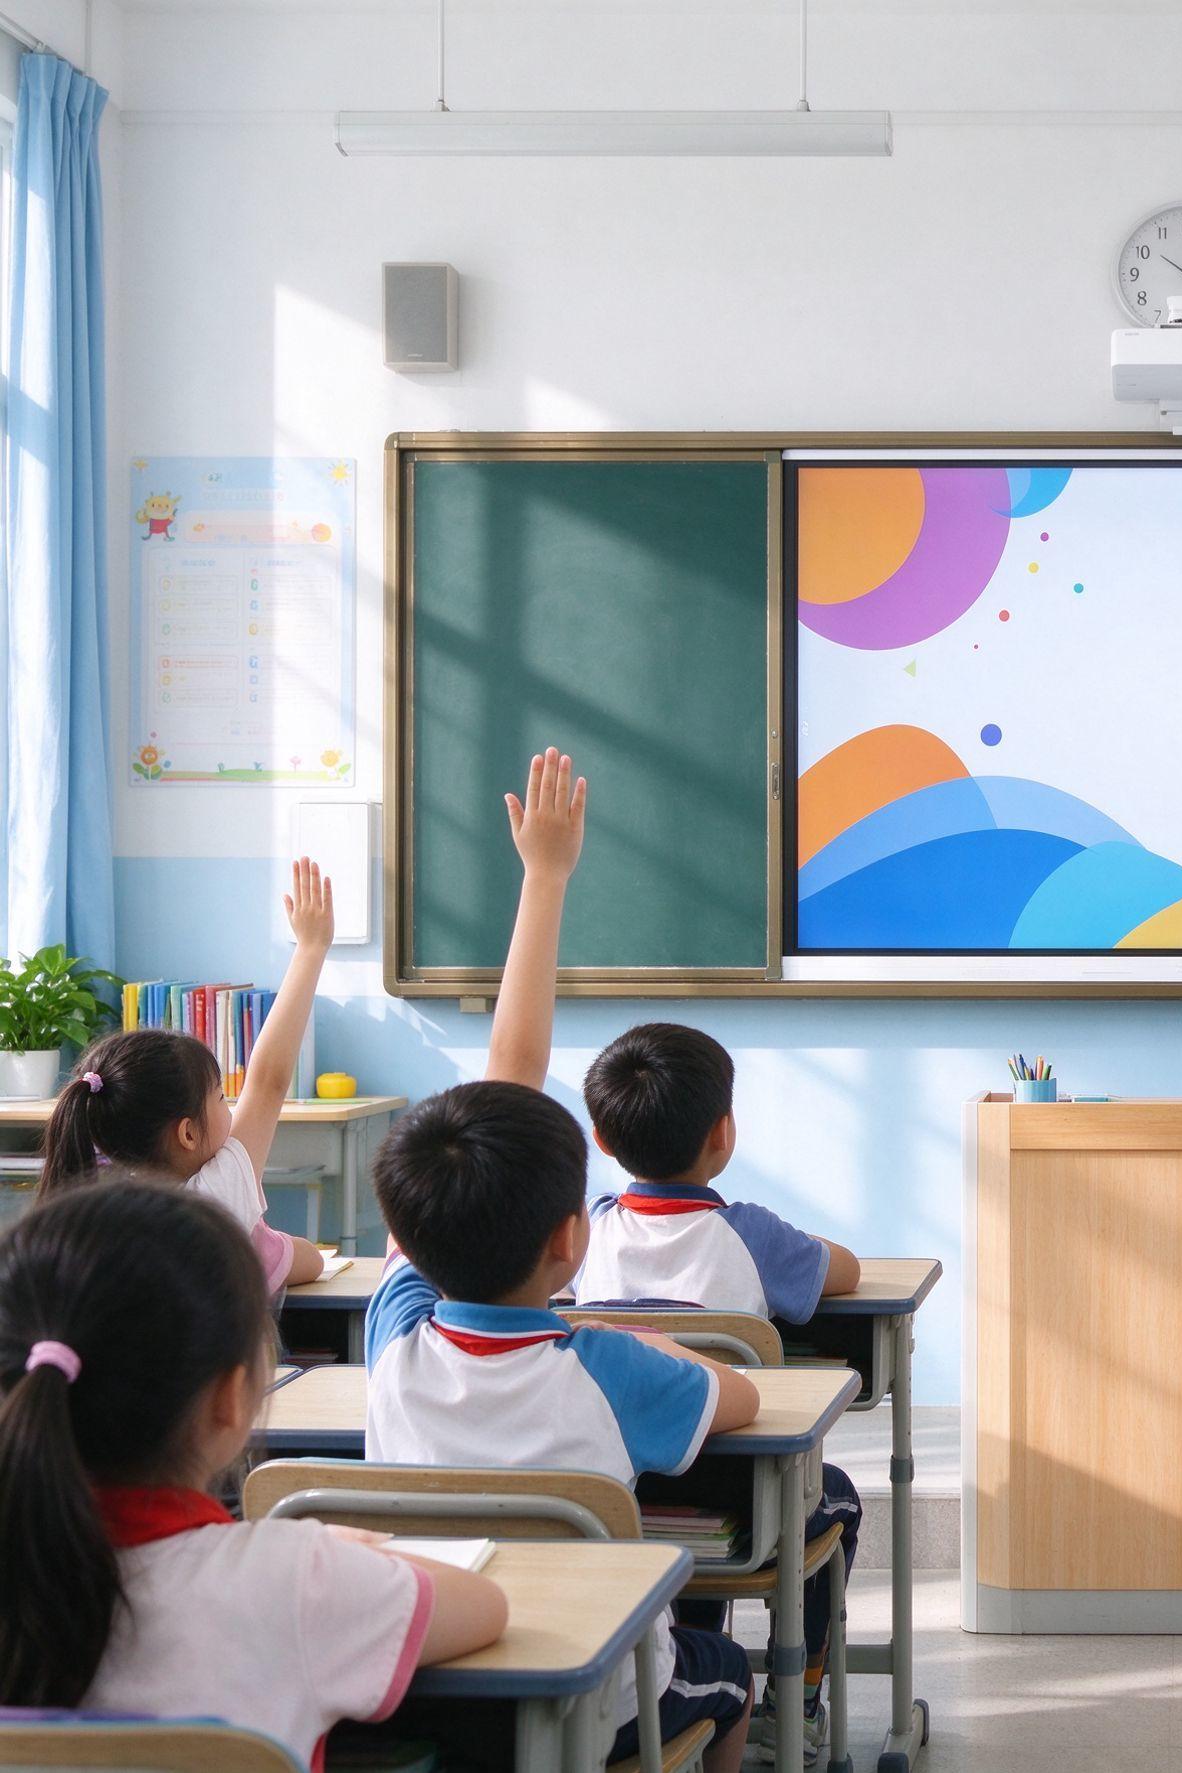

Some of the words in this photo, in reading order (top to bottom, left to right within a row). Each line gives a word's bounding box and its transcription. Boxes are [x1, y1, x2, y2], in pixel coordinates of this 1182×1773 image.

[1158, 227, 1167, 240] 11
[1135, 245, 1150, 260] 10
[1130, 268, 1140, 282] 9
[1137, 290, 1147, 305] 8
[1154, 310, 1162, 323] 7
